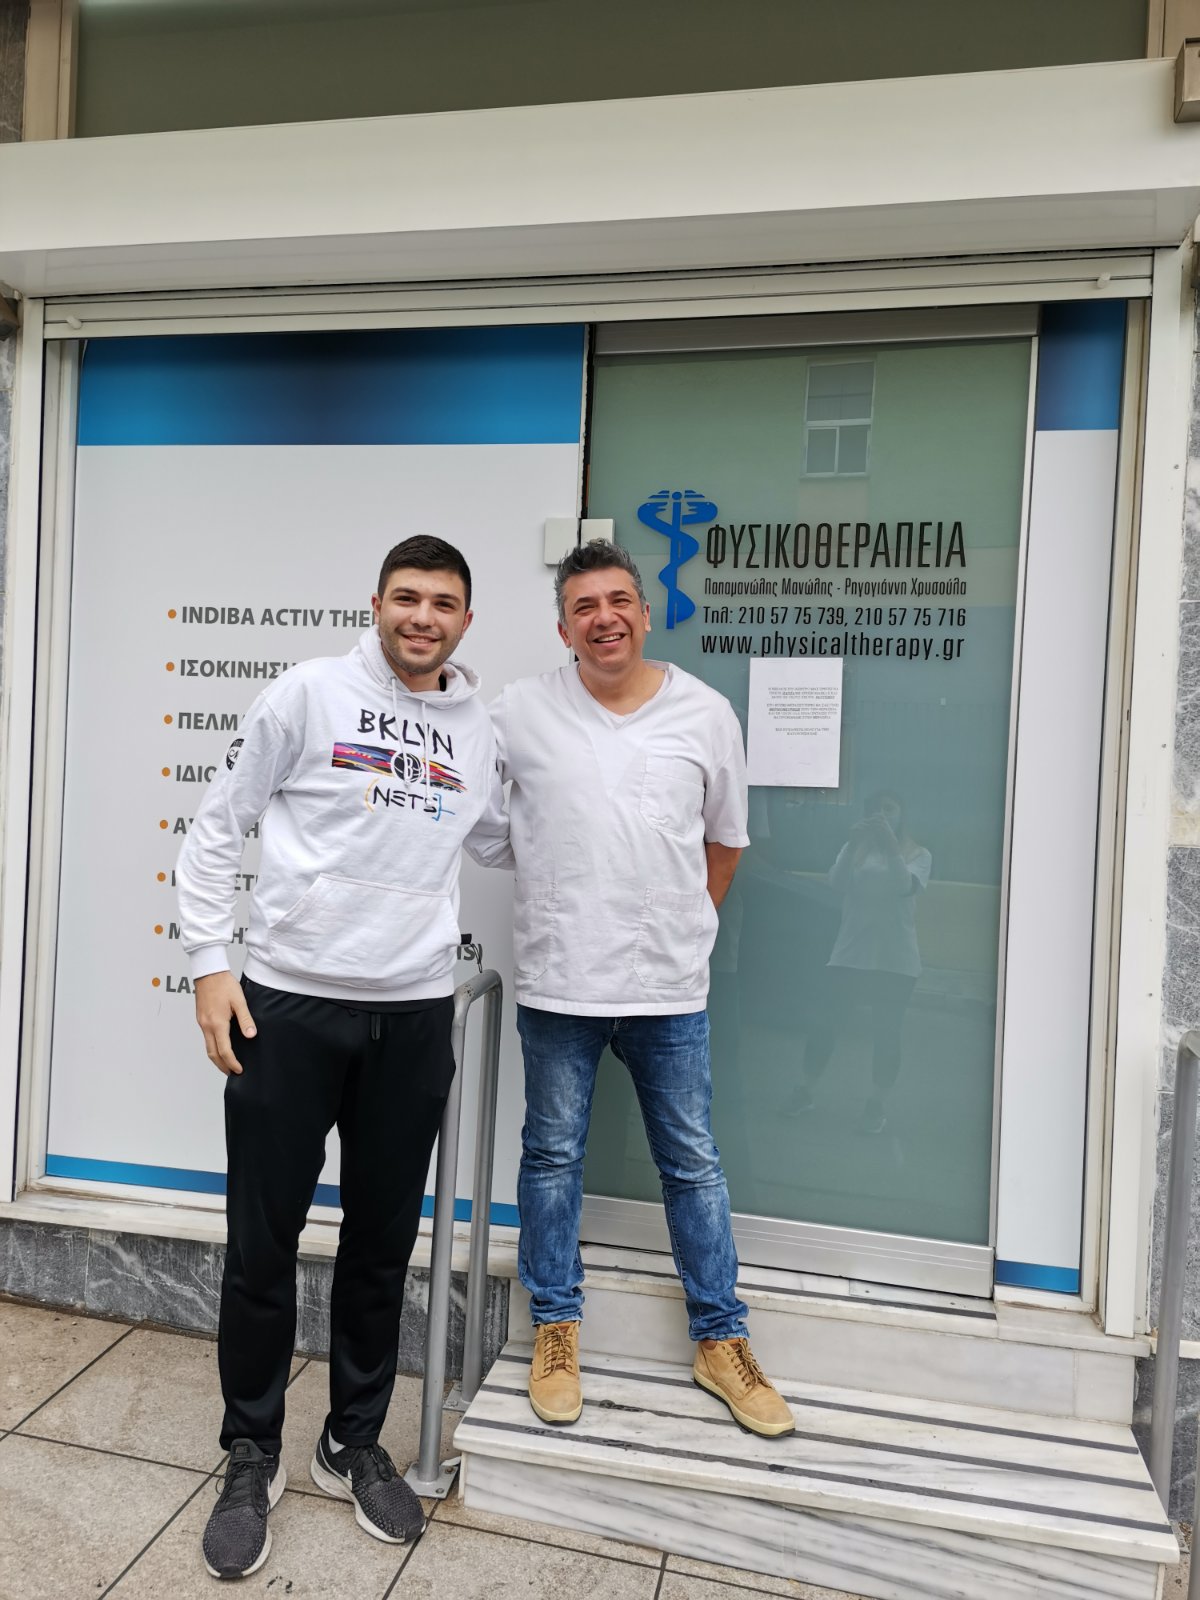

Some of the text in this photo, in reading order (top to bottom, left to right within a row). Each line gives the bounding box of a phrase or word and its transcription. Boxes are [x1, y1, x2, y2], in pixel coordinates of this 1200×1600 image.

[706, 521, 967, 569] ΦΥΣΙΚΟΘΕΡΑΠΕΙΑ
[704, 577, 777, 597] Παπαμανώλης
[781, 577, 833, 597] Μανώλης
[910, 577, 967, 597] Χρυσούλα
[181, 606, 376, 628] INDIBA ACTIV THE
[738, 606, 765, 624] 210
[770, 606, 788, 624] 57
[794, 607, 812, 625] 75
[817, 607, 848, 627] 739,
[854, 607, 882, 626] 210
[888, 608, 907, 626] 57
[913, 608, 931, 626] 75
[937, 608, 966, 626] 716
[701, 631, 965, 661] www.physicaltherapy.gr
